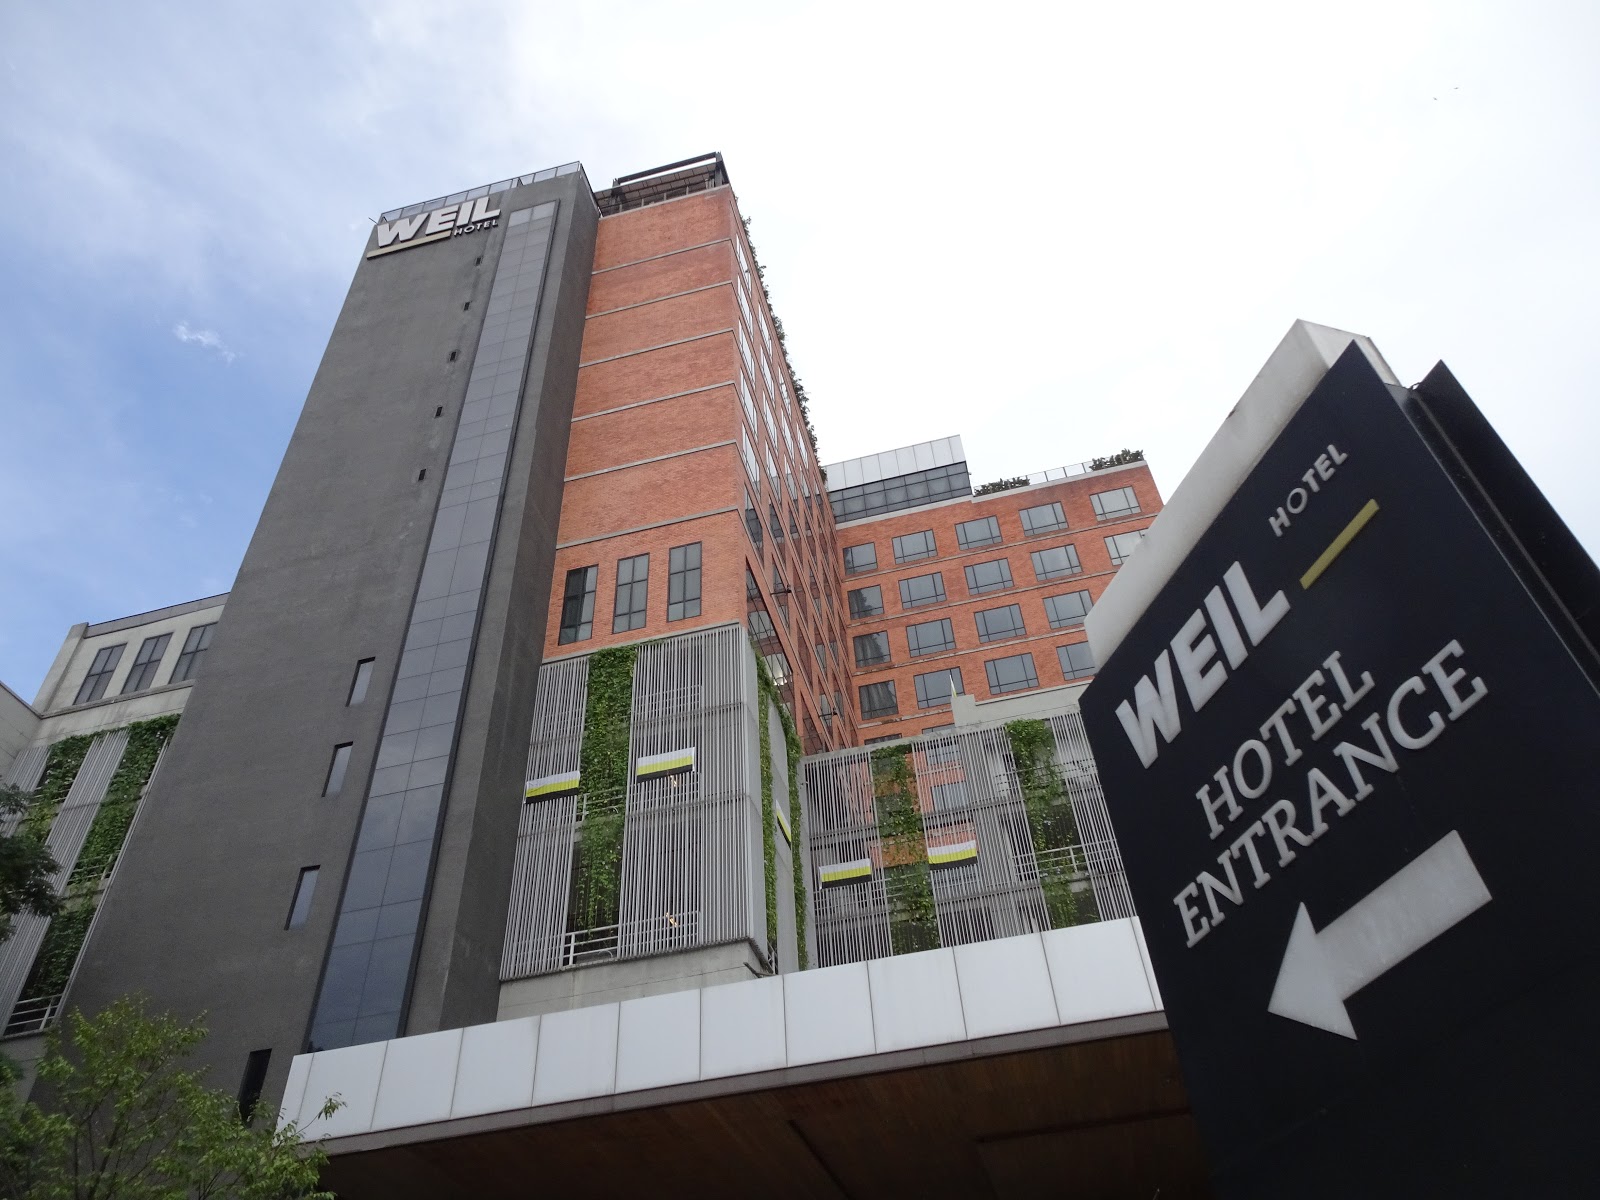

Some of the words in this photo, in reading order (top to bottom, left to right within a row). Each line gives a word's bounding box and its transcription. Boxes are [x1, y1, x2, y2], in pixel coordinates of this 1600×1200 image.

[377, 196, 500, 247] WEIL
[453, 219, 499, 237] HOTEL
[1268, 444, 1348, 537] HOTEL
[1115, 560, 1291, 769] WEIL
[1173, 639, 1488, 948] ENTRANCE
[1196, 650, 1376, 840] HOTEL
